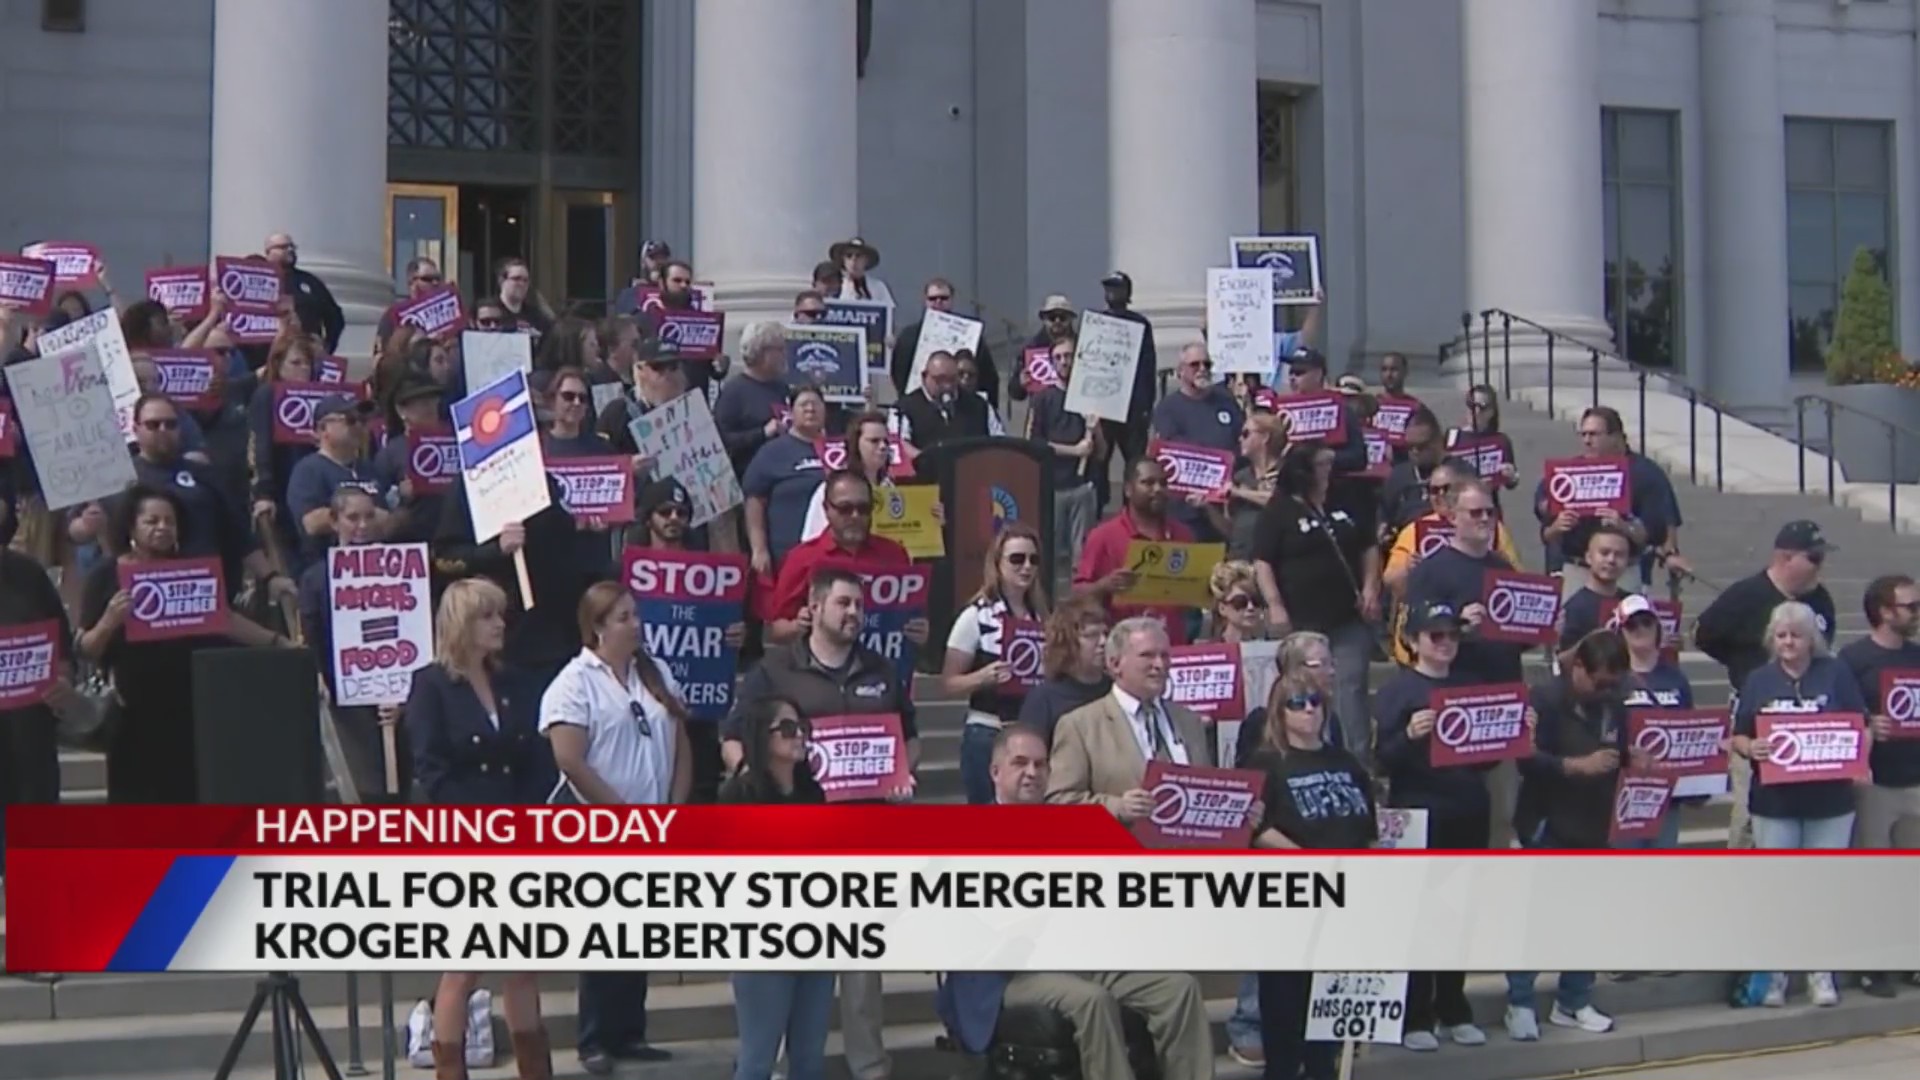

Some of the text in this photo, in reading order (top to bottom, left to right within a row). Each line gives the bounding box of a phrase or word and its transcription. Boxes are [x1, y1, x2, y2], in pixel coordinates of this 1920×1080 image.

[576, 476, 605, 489] STOP
[333, 548, 426, 579] MEGA
[629, 558, 742, 596] STOP
[168, 582, 198, 597] STOP
[671, 604, 697, 621] THE
[643, 622, 723, 659] WAR
[0, 650, 34, 668] STOP
[340, 639, 418, 677] FOOD
[1177, 668, 1231, 683] STOP THE
[1172, 684, 1234, 702] MERGER
[1475, 707, 1505, 723] STOP
[1677, 730, 1706, 743] STOP
[1805, 733, 1837, 745] STOP
[833, 741, 890, 758] STOP THE
[828, 757, 895, 778] MERGER
[1193, 792, 1248, 810] STOP THE
[1180, 808, 1246, 829] MERGER
[1342, 998, 1376, 1018] GOT
[1379, 1000, 1402, 1021] TO
[1332, 1016, 1376, 1041] GO!
